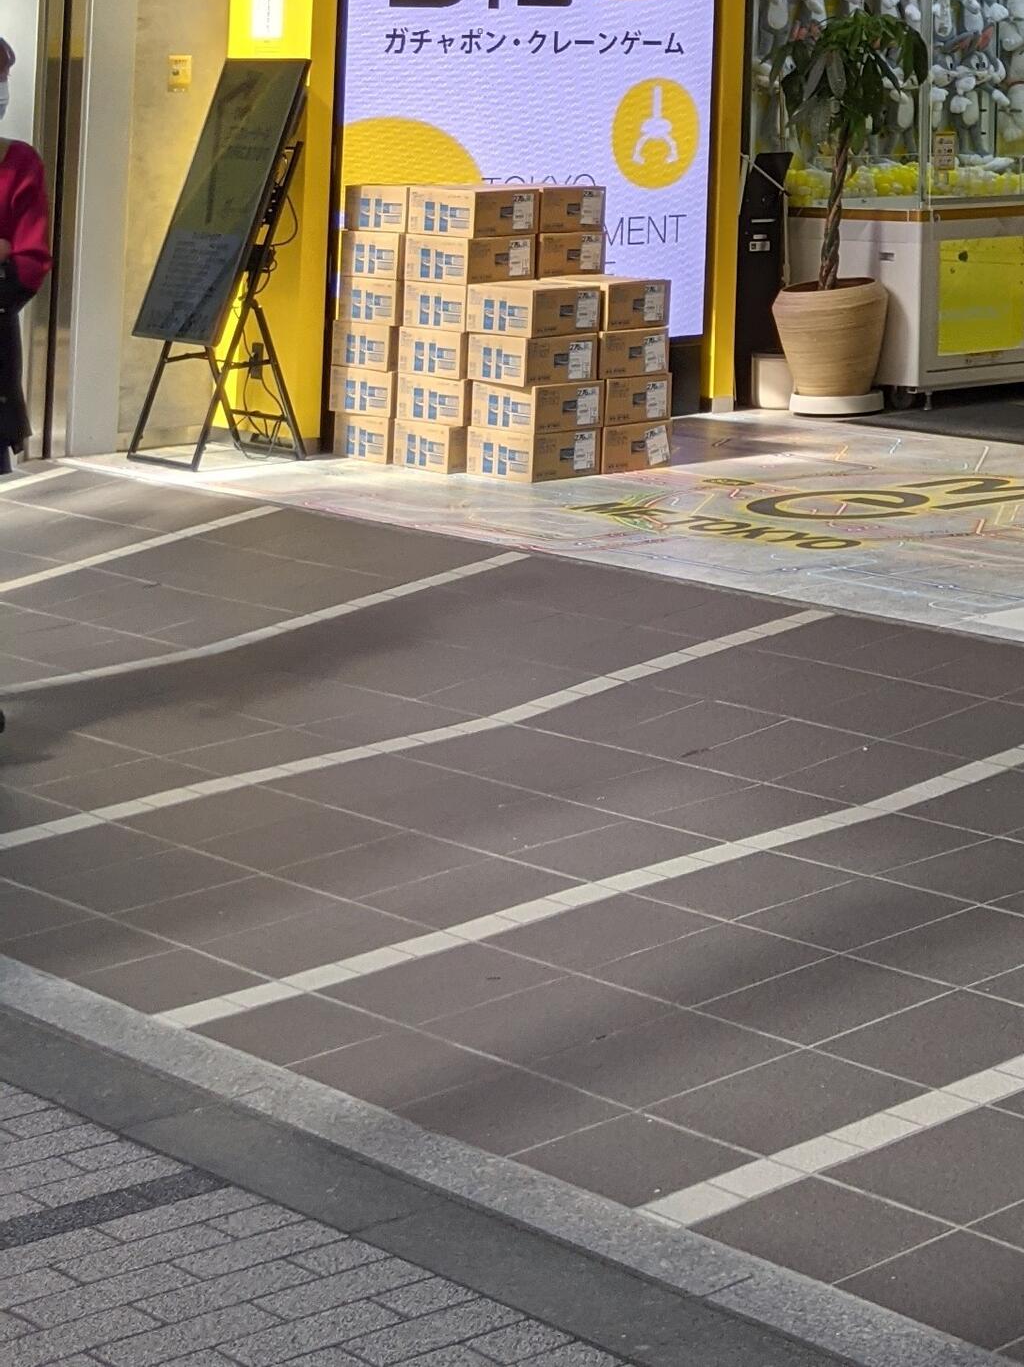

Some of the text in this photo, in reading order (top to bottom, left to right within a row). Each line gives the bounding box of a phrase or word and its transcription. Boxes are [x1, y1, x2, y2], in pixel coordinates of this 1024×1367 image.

[384, 26, 685, 55] ガチャポン・クレーンゲーム
